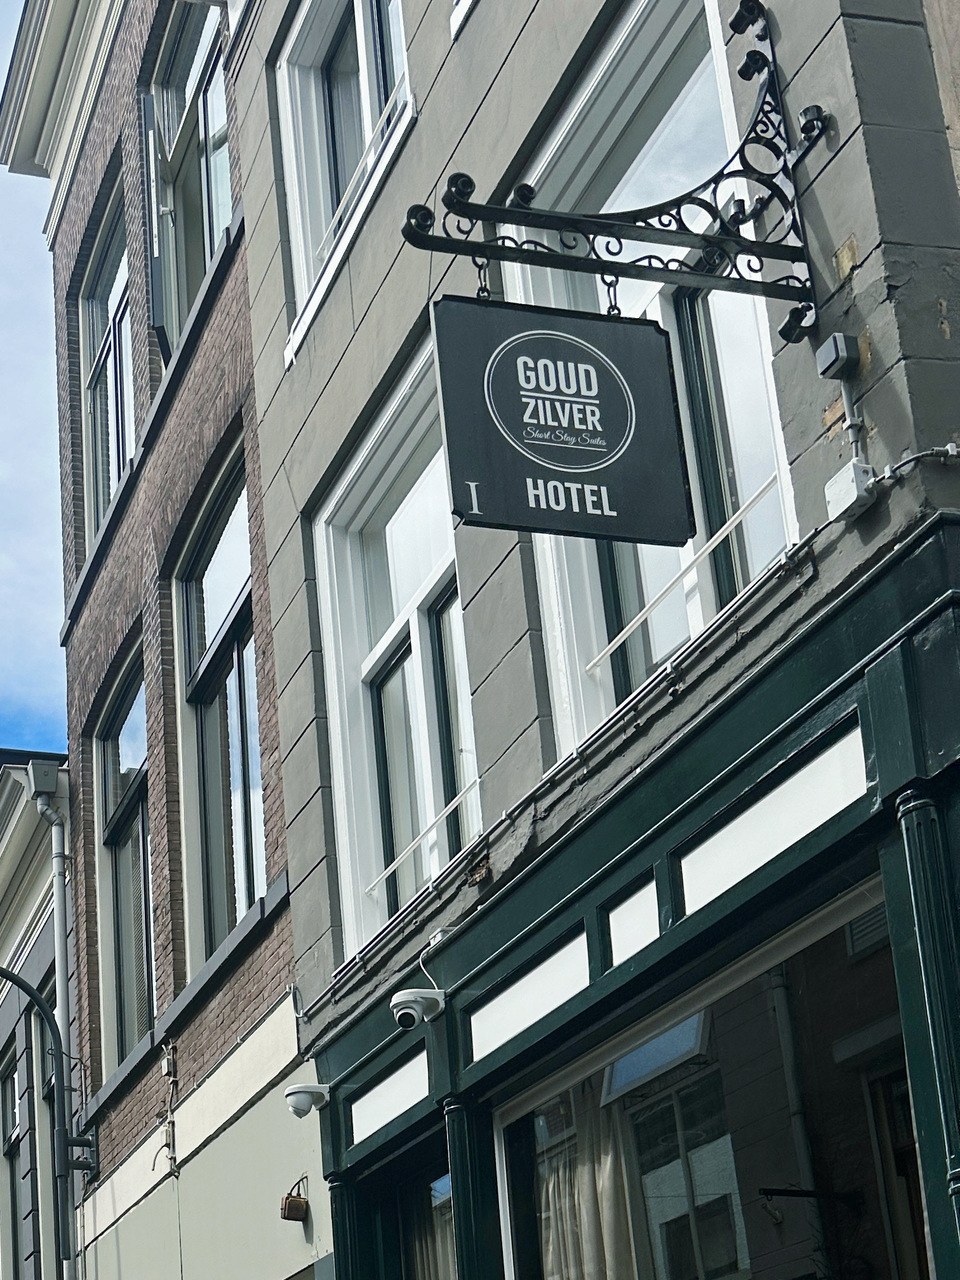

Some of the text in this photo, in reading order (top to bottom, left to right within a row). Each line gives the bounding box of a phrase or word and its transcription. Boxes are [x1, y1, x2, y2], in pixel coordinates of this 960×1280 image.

[516, 356, 599, 397] GOUD
[522, 397, 603, 432] ZILVER
[523, 426, 607, 446] Short Stay Suites
[525, 477, 618, 517] HOTEL
